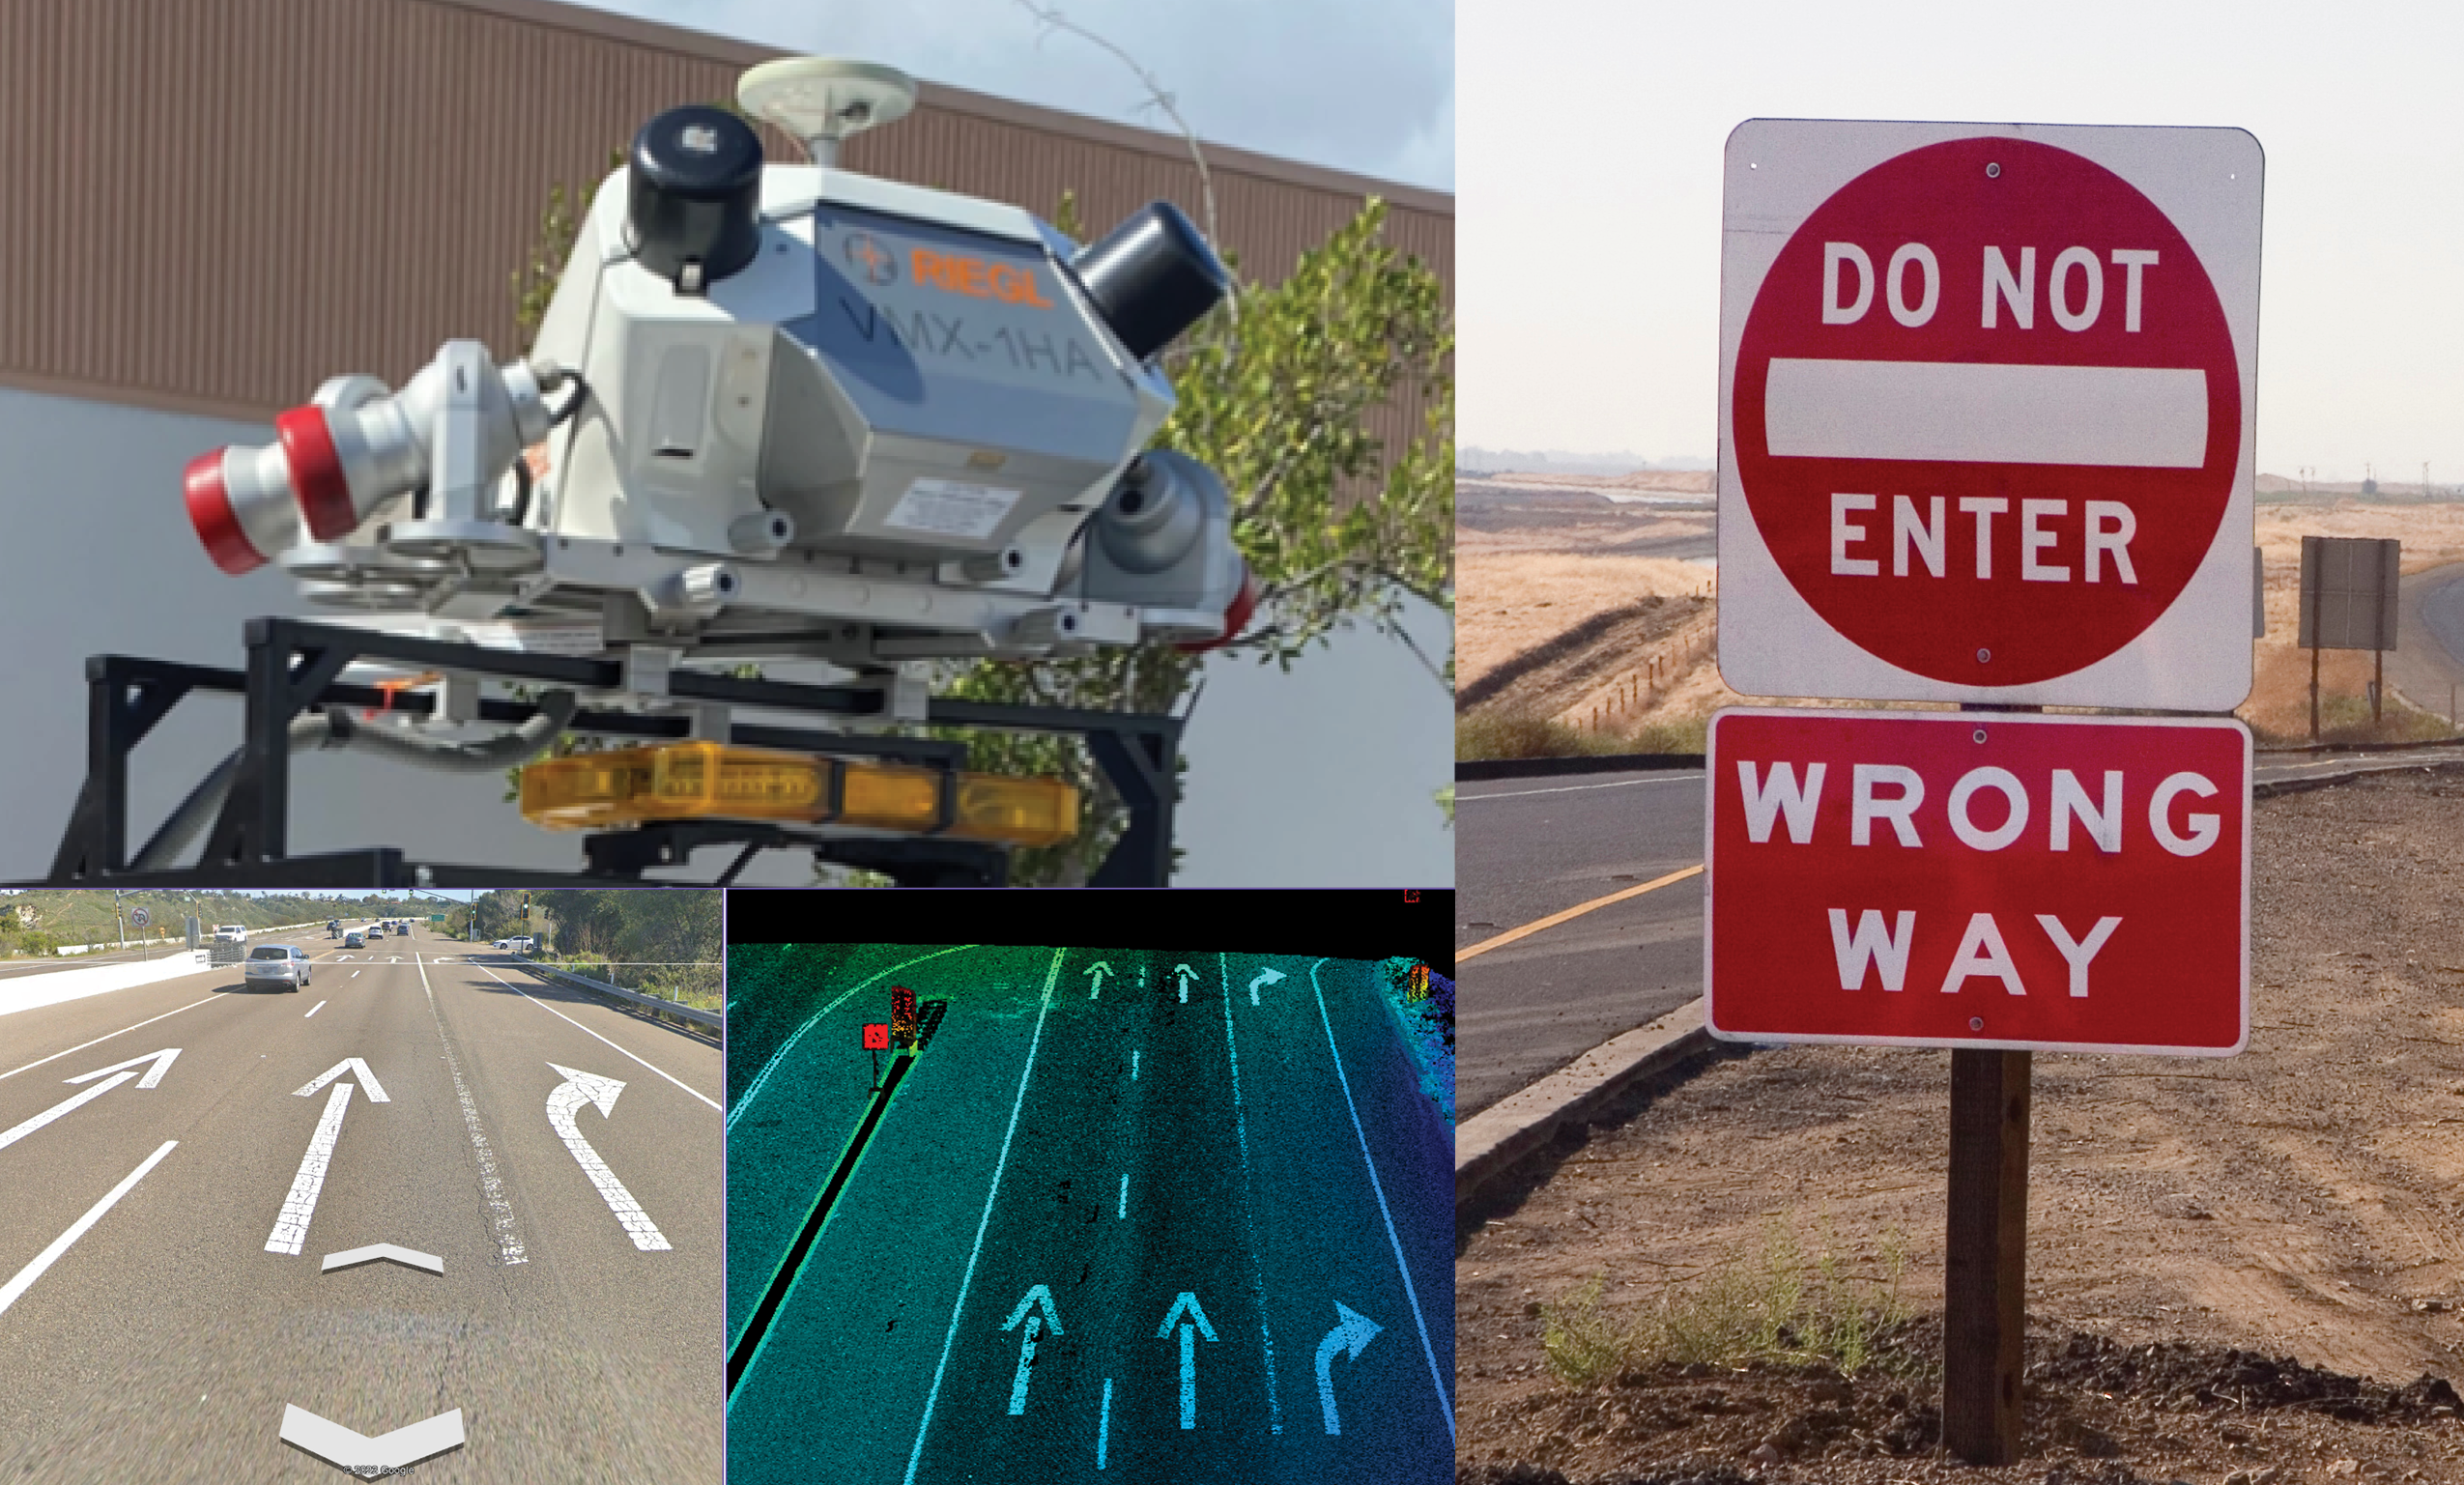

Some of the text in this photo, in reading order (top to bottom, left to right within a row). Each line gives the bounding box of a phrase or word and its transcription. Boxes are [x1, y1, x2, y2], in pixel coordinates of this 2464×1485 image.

[910, 248, 1054, 310] RIEGL
[1821, 241, 2160, 333] DO NOT
[838, 296, 1103, 382] VMX-1HA
[1830, 492, 2138, 585] ENTER
[1736, 759, 2221, 858] WRONG
[1827, 907, 2124, 999] WAY
